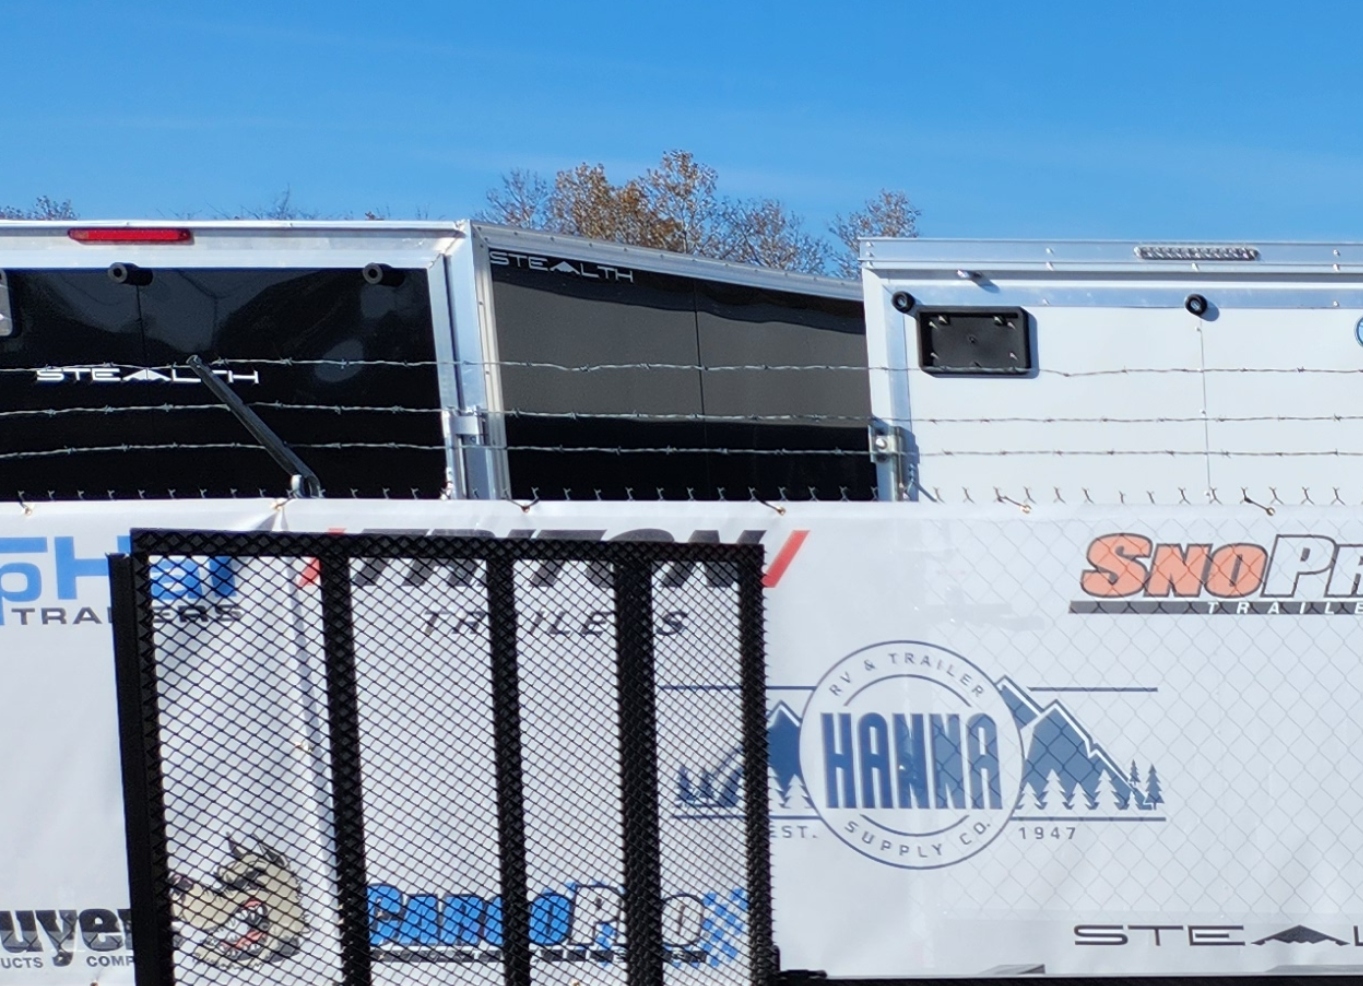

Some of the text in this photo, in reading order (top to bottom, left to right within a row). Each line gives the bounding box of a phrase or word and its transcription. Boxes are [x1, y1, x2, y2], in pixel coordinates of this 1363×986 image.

[489, 251, 634, 283] STEALTH
[11, 605, 243, 625] TRAERS
[423, 611, 689, 637] TRILES
[828, 671, 852, 697] RV
[887, 652, 986, 698] TRAILER
[820, 712, 1003, 810] HANNA
[844, 820, 992, 858] SUPPLY CO.
[1018, 827, 1076, 840] 1947
[86, 955, 134, 967] COMP
